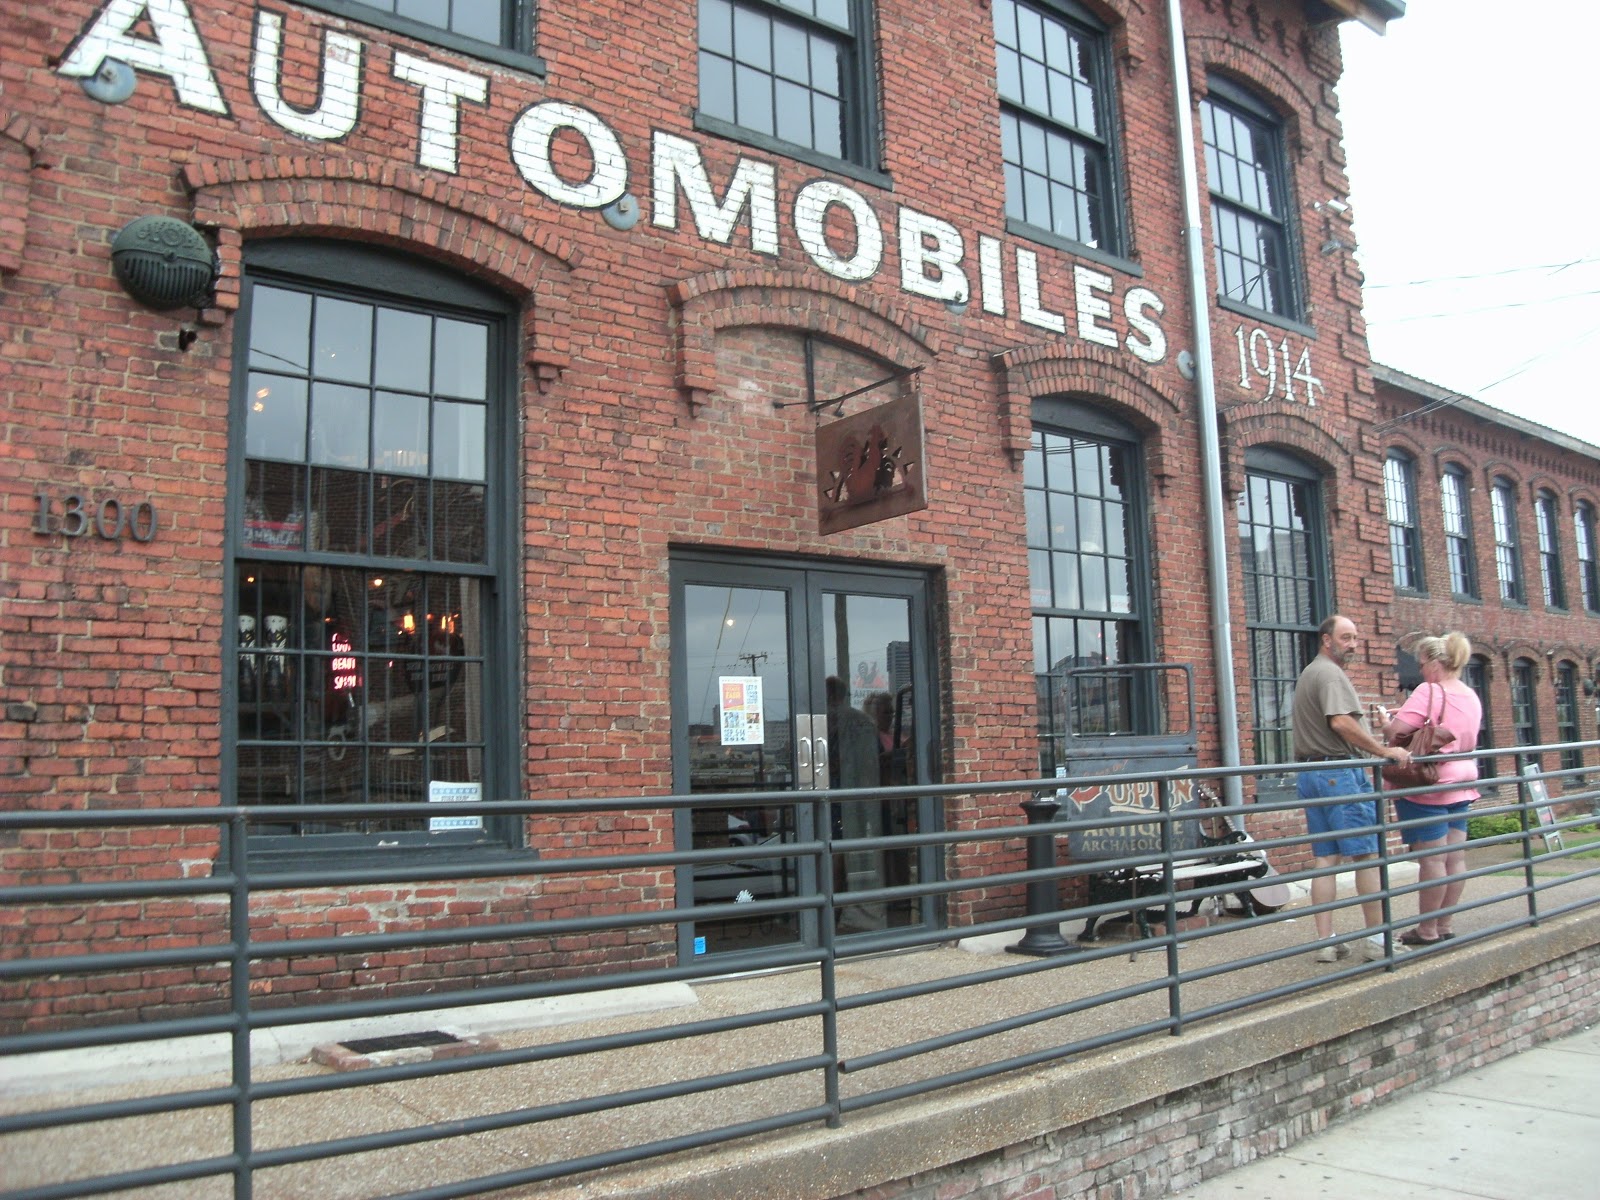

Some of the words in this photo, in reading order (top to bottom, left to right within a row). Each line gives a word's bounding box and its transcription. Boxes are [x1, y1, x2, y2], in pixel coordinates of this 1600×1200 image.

[57, 0, 1168, 363] AUTOMOBILES
[1235, 325, 1325, 406] 1914
[34, 493, 157, 541] 1300
[1083, 820, 1184, 837] ANTIQE
